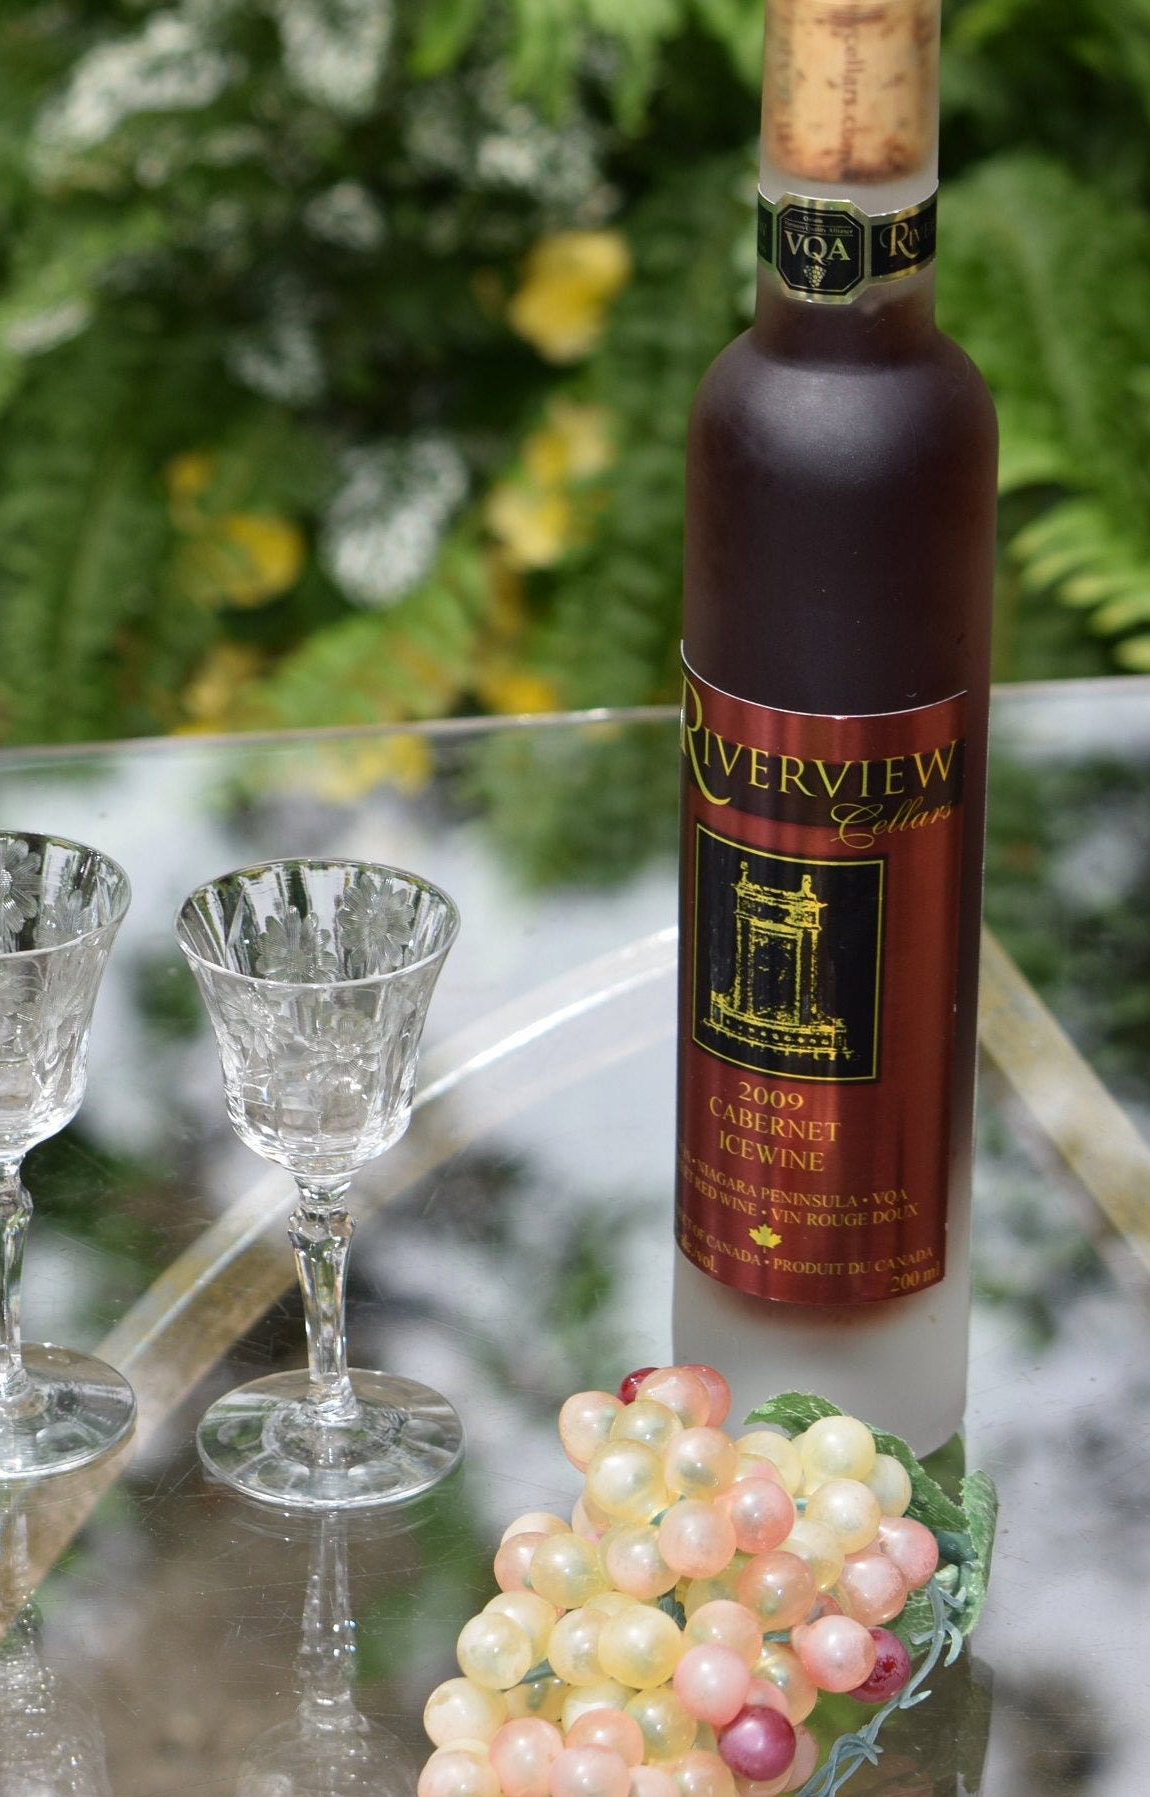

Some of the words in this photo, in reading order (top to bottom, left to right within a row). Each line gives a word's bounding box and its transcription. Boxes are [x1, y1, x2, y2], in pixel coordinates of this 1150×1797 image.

[785, 231, 851, 266] VQA
[830, 796, 953, 849] Cellars
[738, 1081, 804, 1111] 2009
[709, 1096, 841, 1142] CABERNET
[719, 1130, 826, 1172] ICEWINE
[695, 1159, 757, 1198] NIAGARA
[761, 1187, 858, 1208] PENINSULA
[872, 1189, 908, 1205] VQA
[695, 1178, 717, 1200] RED
[719, 1191, 757, 1216] WINE
[771, 1208, 801, 1224] VIN
[807, 1212, 868, 1227] ROUGE
[872, 1202, 918, 1224] DOUX
[706, 1235, 761, 1266] CANADA
[773, 1258, 844, 1275] PRODUIT
[848, 1261, 870, 1275] DU
[874, 1247, 933, 1272] CANADA
[890, 1270, 920, 1292] 200
[923, 1260, 940, 1282] ml
